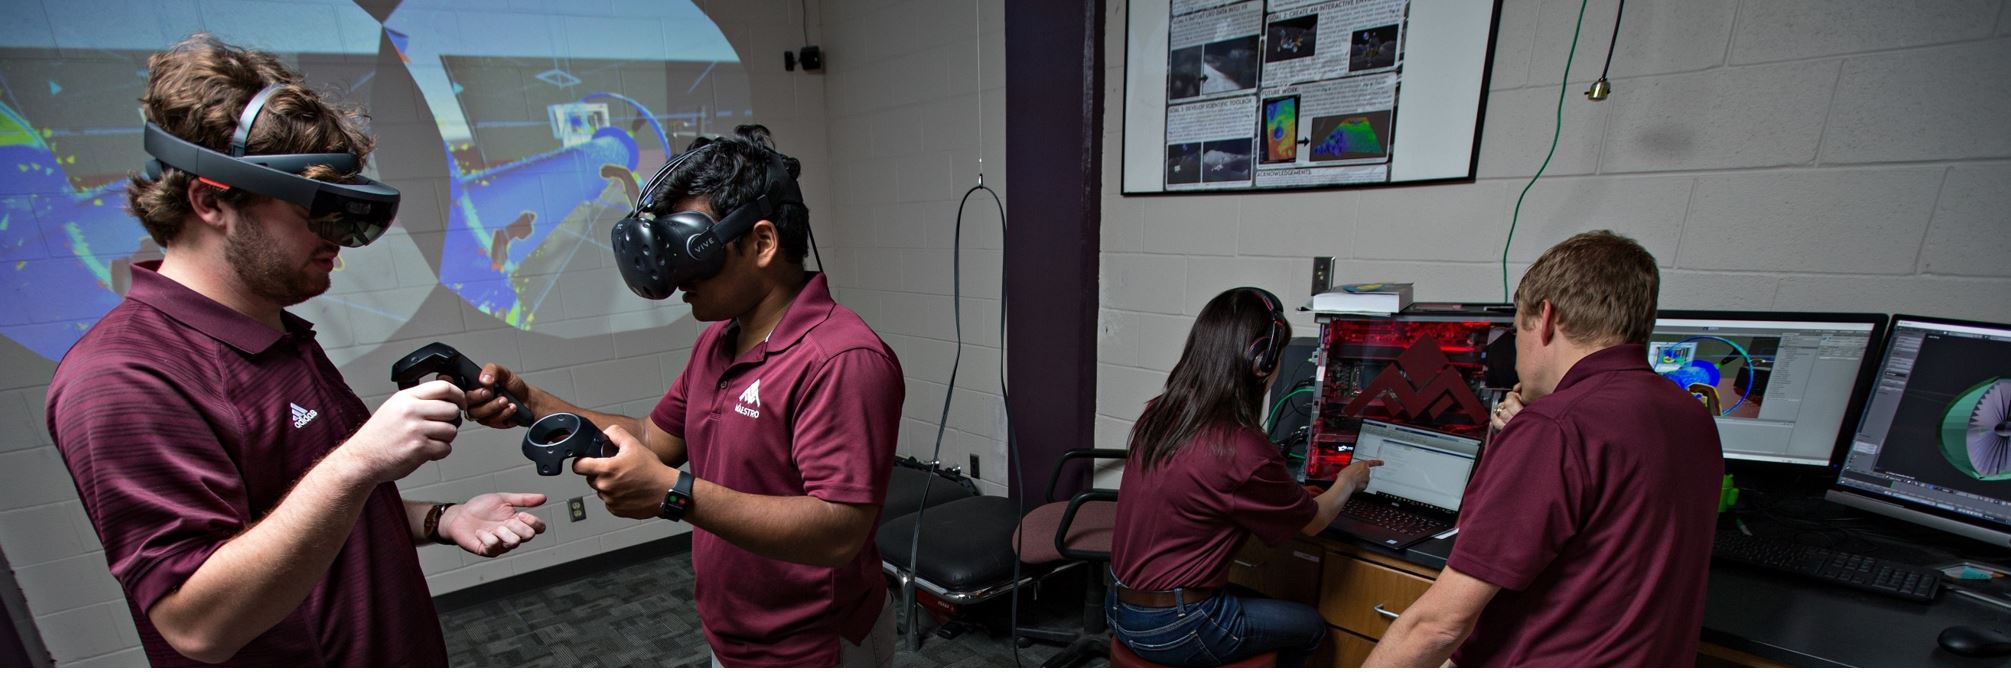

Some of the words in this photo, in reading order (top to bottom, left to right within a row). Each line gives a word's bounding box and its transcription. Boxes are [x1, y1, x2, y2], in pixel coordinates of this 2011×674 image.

[694, 237, 715, 253] VIVE
[294, 409, 318, 429] adidas
[734, 402, 760, 419] MAESTRO
